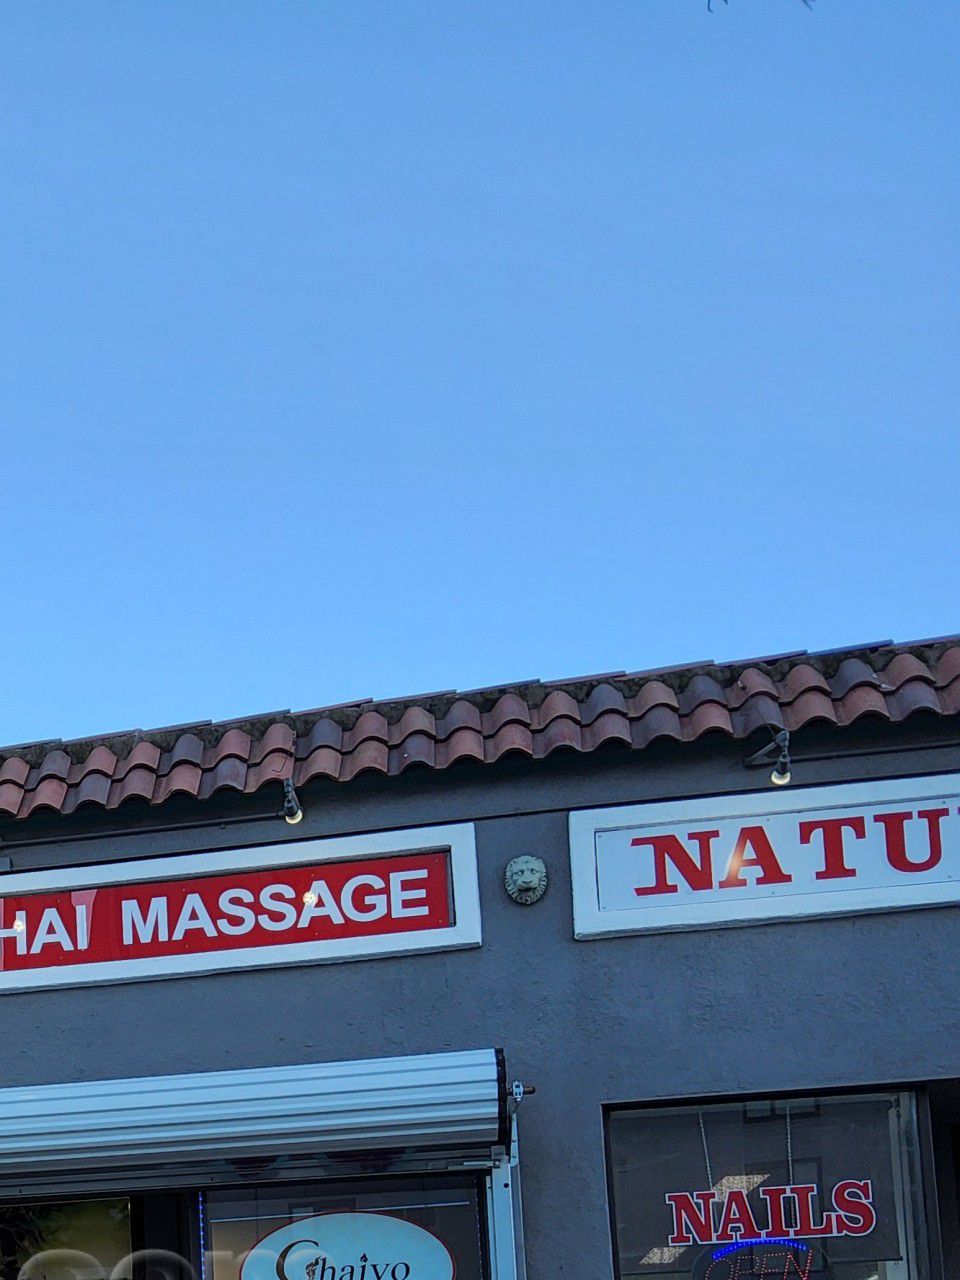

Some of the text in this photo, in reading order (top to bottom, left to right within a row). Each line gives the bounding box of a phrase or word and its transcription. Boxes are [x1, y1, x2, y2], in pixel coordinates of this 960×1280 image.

[630, 806, 960, 896] NATU
[121, 868, 430, 946] MASSAGE
[665, 1180, 876, 1246] NAILS
